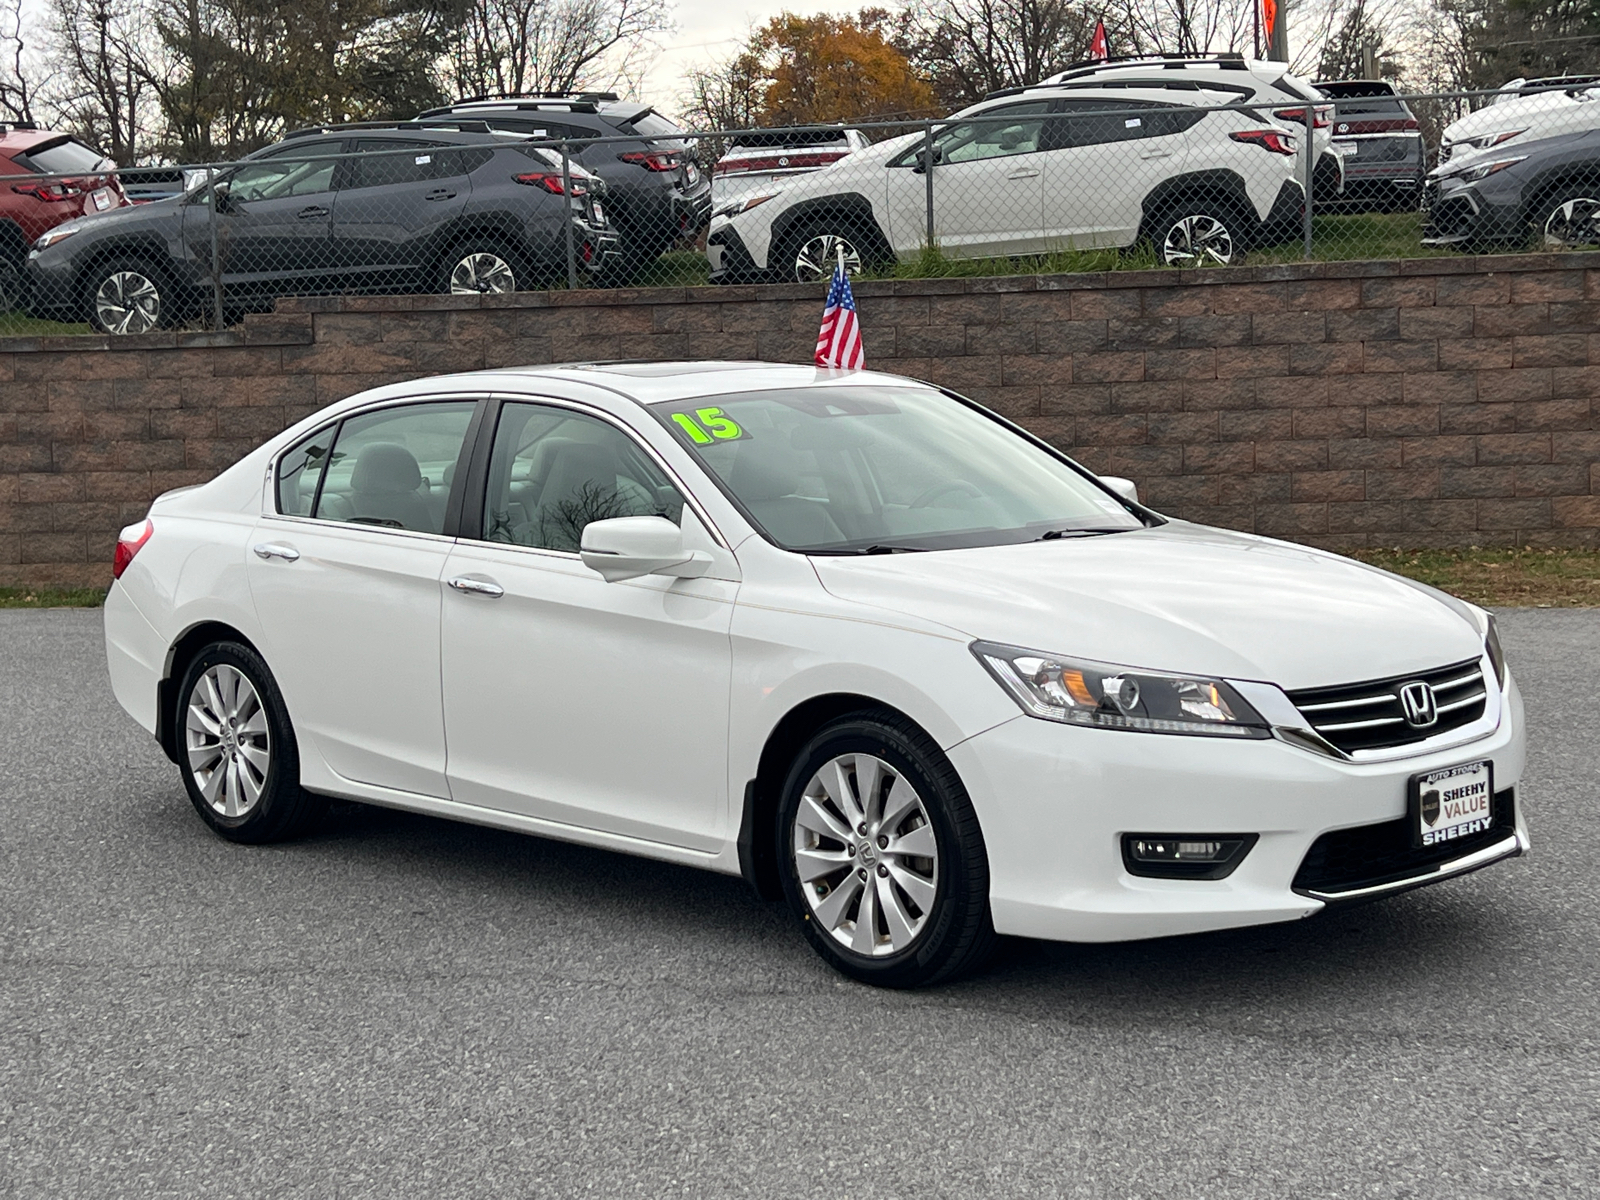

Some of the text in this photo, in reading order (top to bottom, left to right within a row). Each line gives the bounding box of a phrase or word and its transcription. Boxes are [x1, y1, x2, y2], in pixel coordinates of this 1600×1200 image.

[671, 407, 743, 444] 15
[1427, 762, 1484, 783] AUTO STORES
[1443, 781, 1486, 802] SHEEHY
[1444, 795, 1487, 819] VALUE
[1423, 816, 1492, 846] SHEEHY
